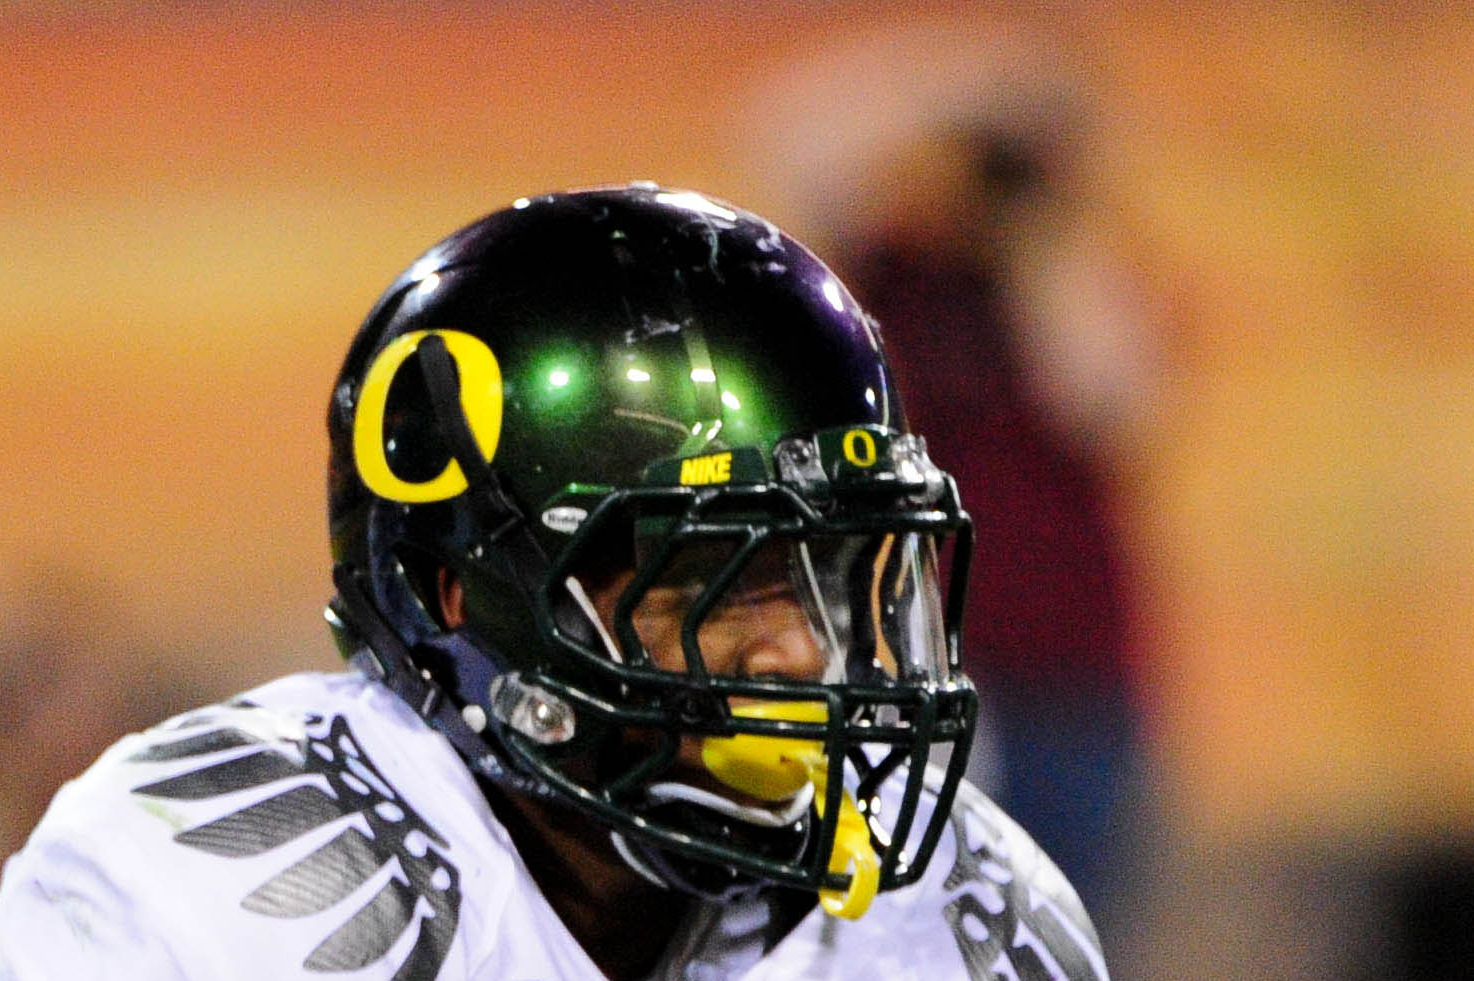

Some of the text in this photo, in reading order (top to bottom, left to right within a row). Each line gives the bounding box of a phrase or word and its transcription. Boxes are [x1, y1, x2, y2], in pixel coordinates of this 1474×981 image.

[353, 328, 503, 504] O
[843, 429, 876, 467] O
[680, 452, 732, 487] NIKE
